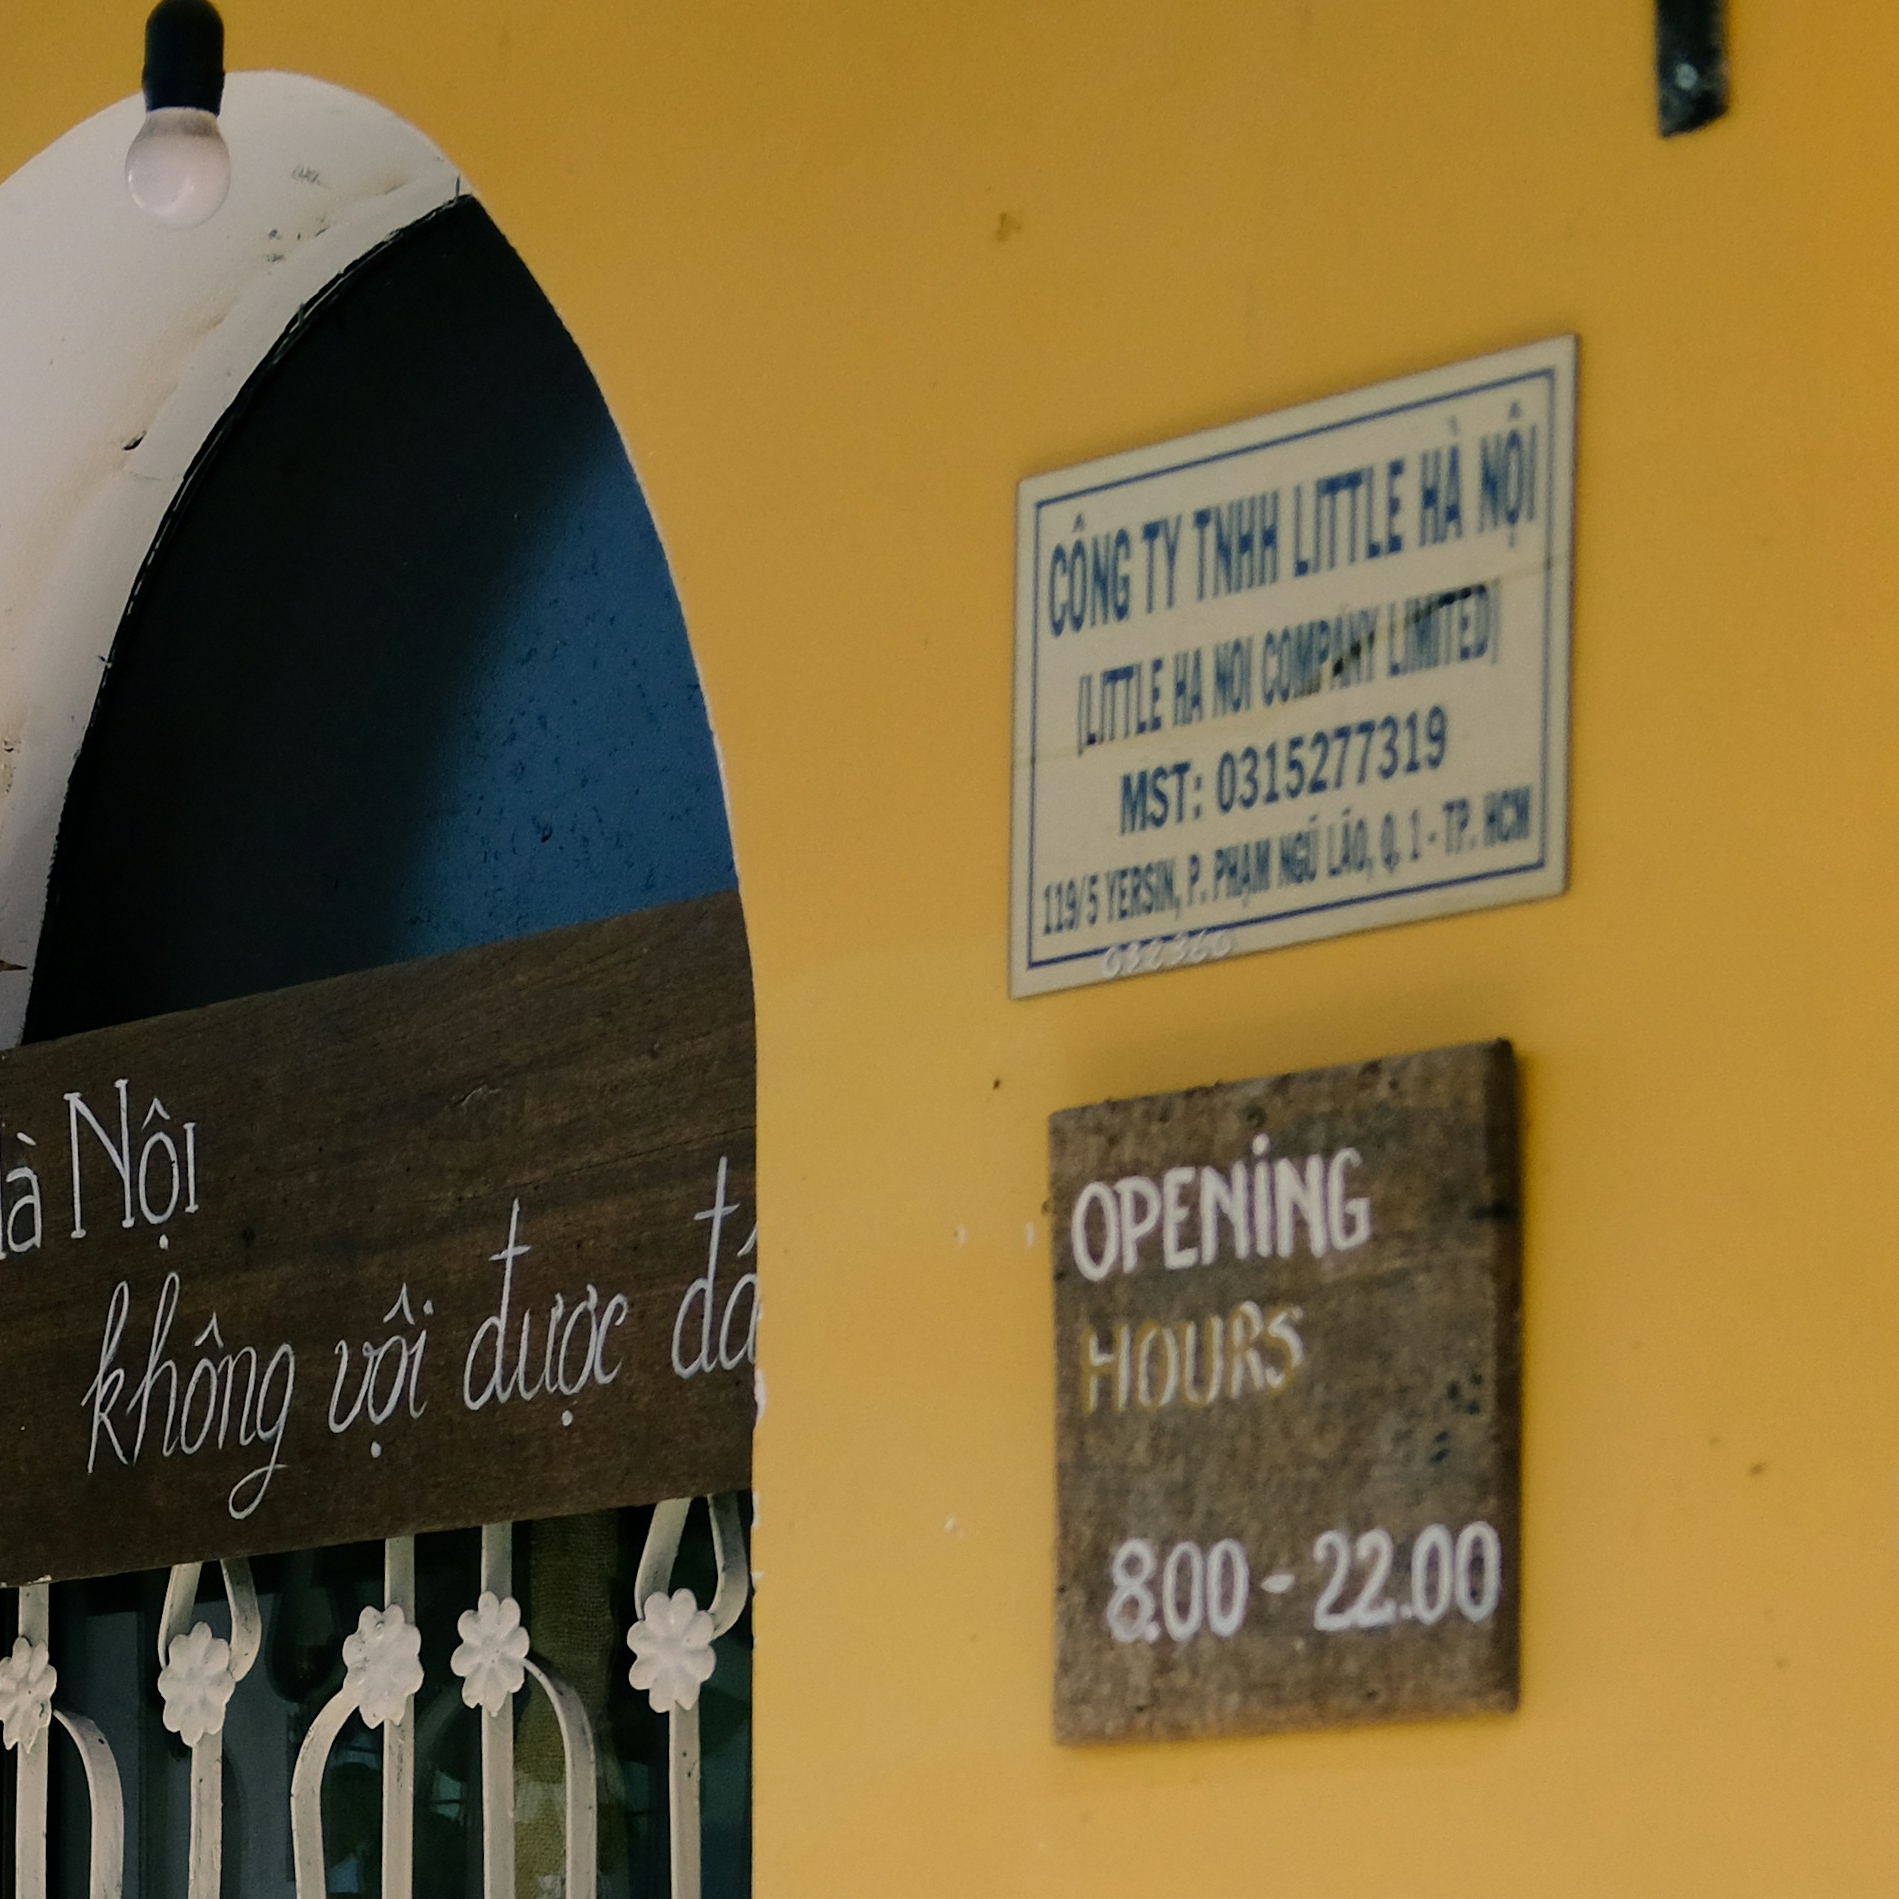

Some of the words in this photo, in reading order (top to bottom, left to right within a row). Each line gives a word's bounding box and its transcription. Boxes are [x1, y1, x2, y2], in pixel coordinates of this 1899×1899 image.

[1047, 512, 1132, 638] CÔNG
[1142, 515, 1181, 614] TY
[1193, 490, 1279, 602] TNHH
[1293, 457, 1405, 579] LITTLE
[1419, 416, 1462, 547] HÀ
[1479, 402, 1537, 548] NỘI
[1077, 657, 1163, 756] (LITTLE
[1173, 645, 1204, 728] HA
[1212, 635, 1253, 719] NOI
[1261, 606, 1378, 706] COMPANY
[1119, 761, 1203, 835] MST:
[1216, 705, 1448, 814] 0315277319
[1042, 873, 1099, 935] 119/5
[1188, 854, 1208, 906] P.
[1483, 786, 1531, 846] HCM
[64, 1078, 199, 1249] Nội
[82, 1271, 295, 1520] không
[328, 1282, 433, 1459] vội
[463, 1198, 629, 1427] được
[1082, 1301, 1306, 1412] HOURS
